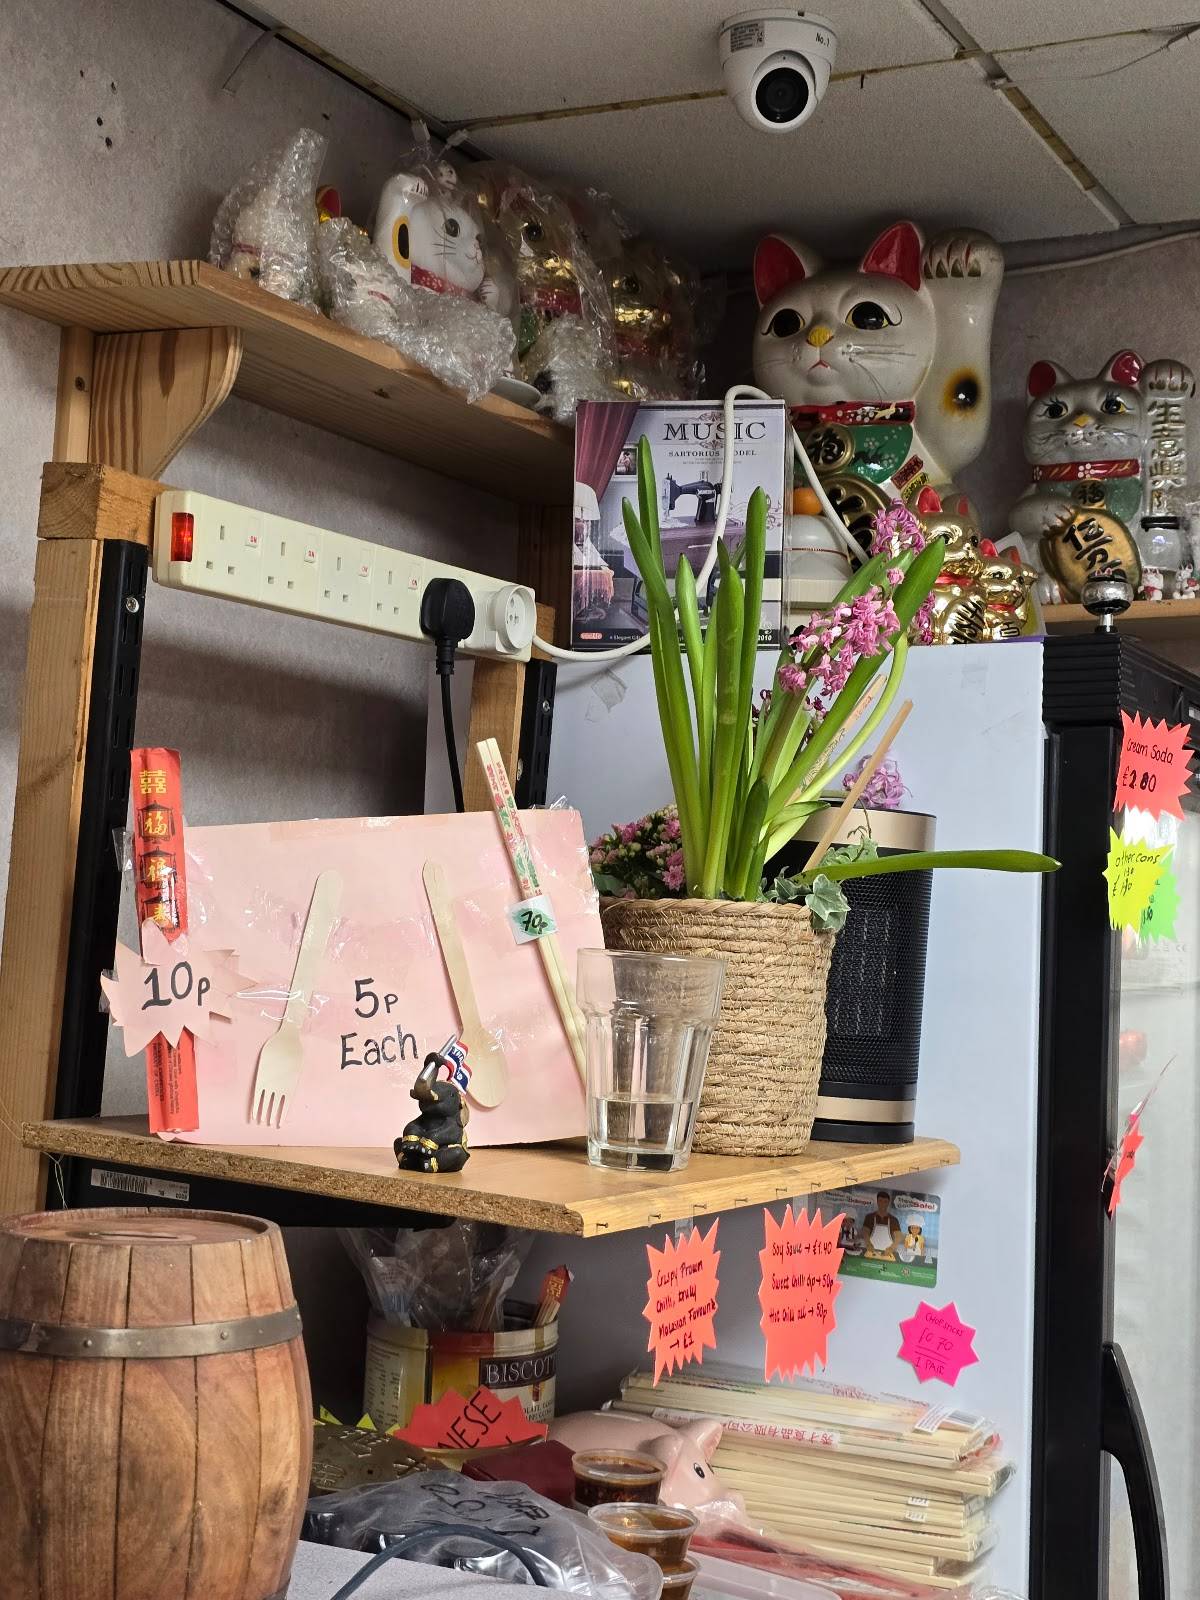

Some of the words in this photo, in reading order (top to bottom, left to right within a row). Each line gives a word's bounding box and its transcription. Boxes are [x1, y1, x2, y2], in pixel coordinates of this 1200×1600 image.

[662, 421, 766, 441] MUSIC
[1126, 738, 1148, 757] Cream
[1151, 744, 1174, 764] Soda
[521, 910, 549, 935] 70p
[143, 960, 210, 1010] 10p
[340, 1025, 418, 1070] Each
[925, 1359, 945, 1376] PAIR
